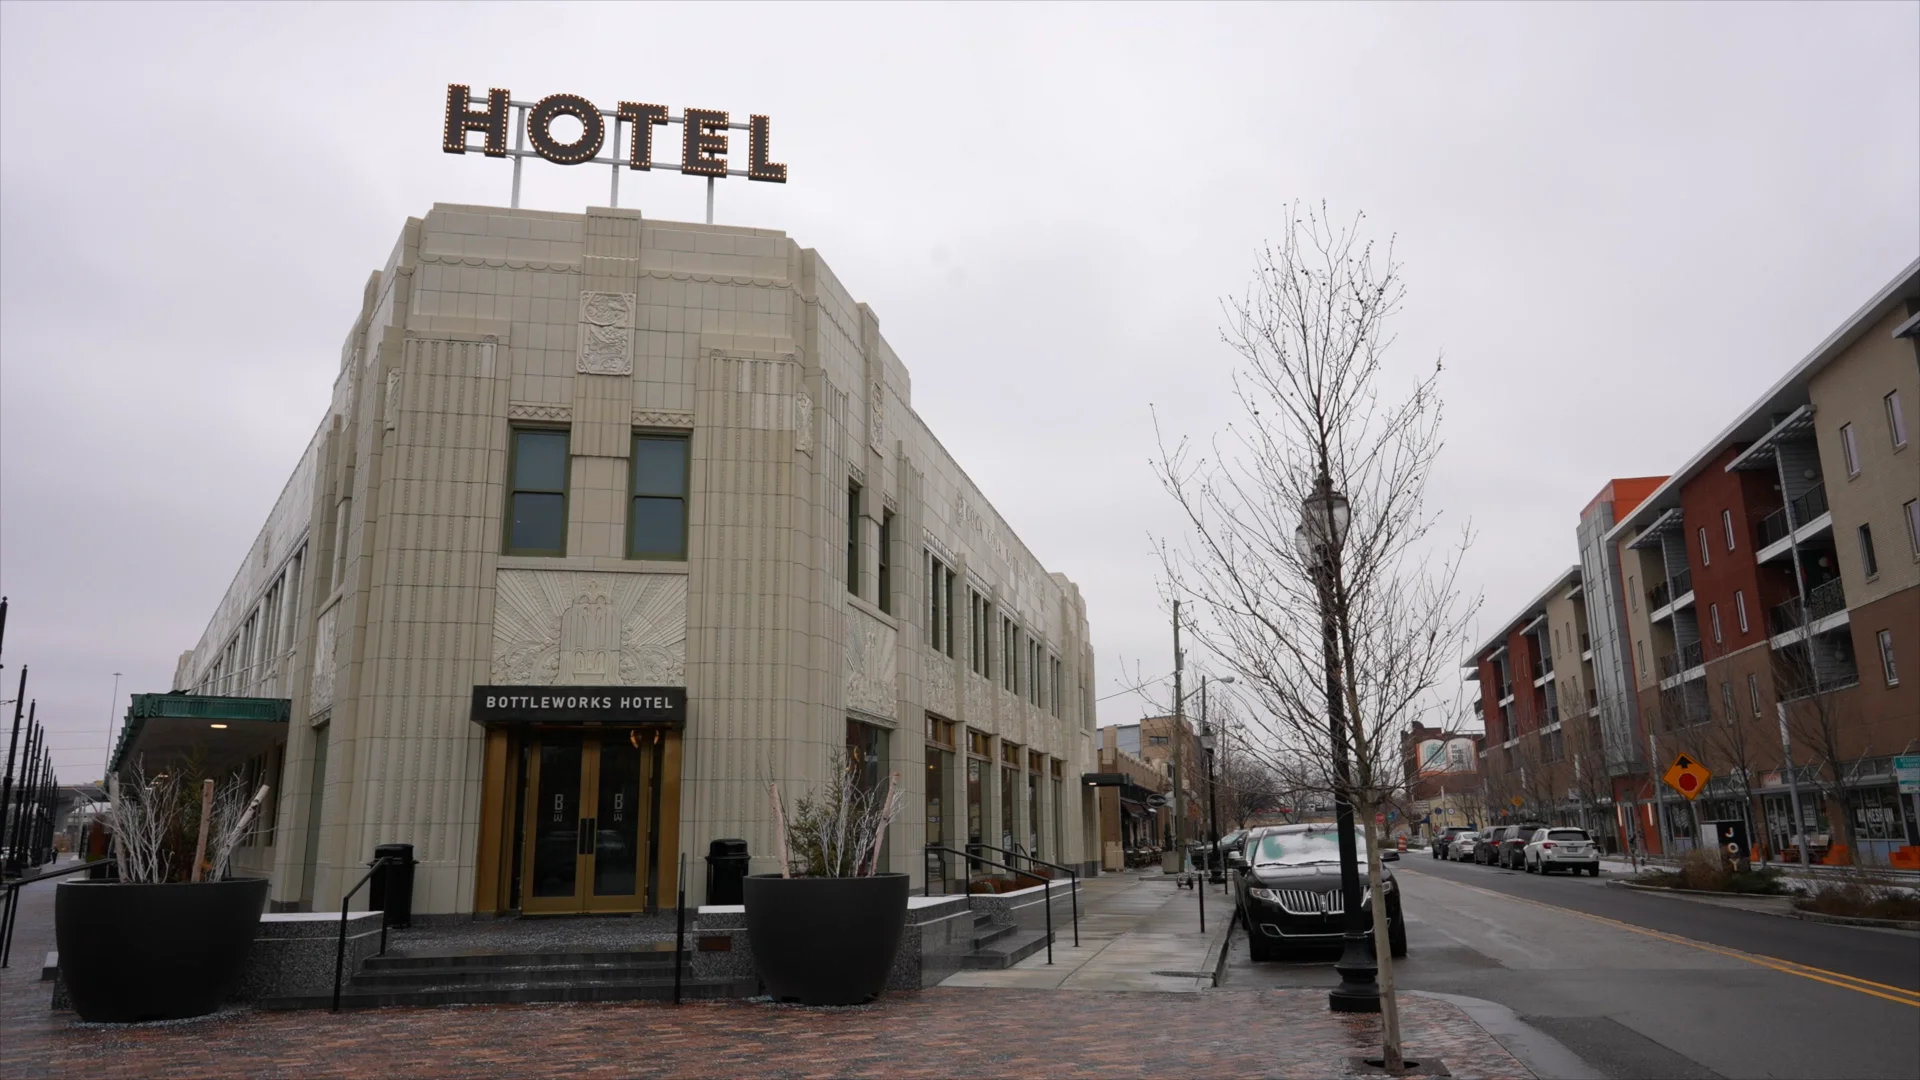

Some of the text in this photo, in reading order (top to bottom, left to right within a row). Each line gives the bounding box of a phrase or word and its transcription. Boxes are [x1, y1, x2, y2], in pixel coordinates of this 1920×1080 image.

[443, 83, 787, 183] HOTEL
[965, 505, 983, 537] COCA
[987, 529, 1001, 556] COLA
[486, 696, 673, 709] BOTTLEWORKS HOTEL
[554, 794, 564, 810] B
[614, 793, 623, 810] B
[1725, 827, 1739, 871] JOY
